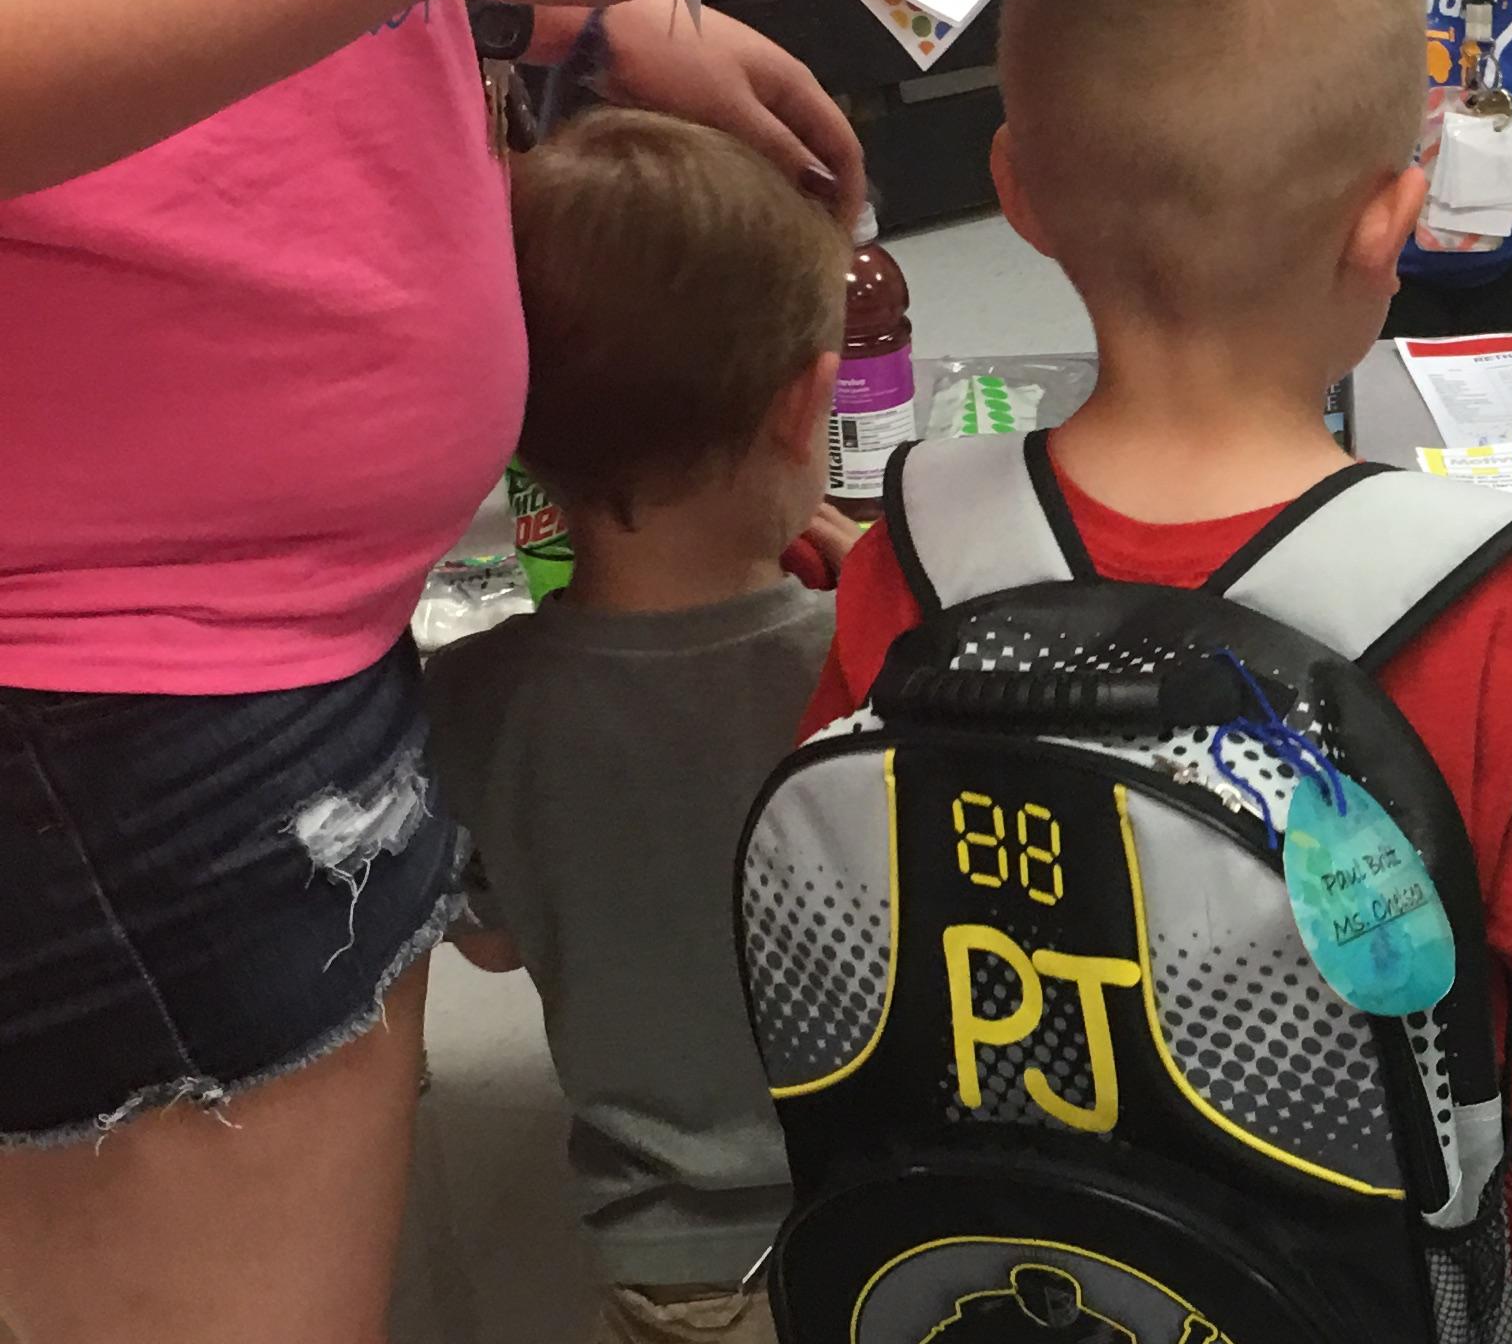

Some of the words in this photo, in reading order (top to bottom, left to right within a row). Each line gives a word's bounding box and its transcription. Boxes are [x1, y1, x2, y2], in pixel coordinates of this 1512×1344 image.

[952, 791, 1064, 906] 88
[1333, 912, 1371, 942] Ms.
[943, 924, 1142, 1134] PJ
